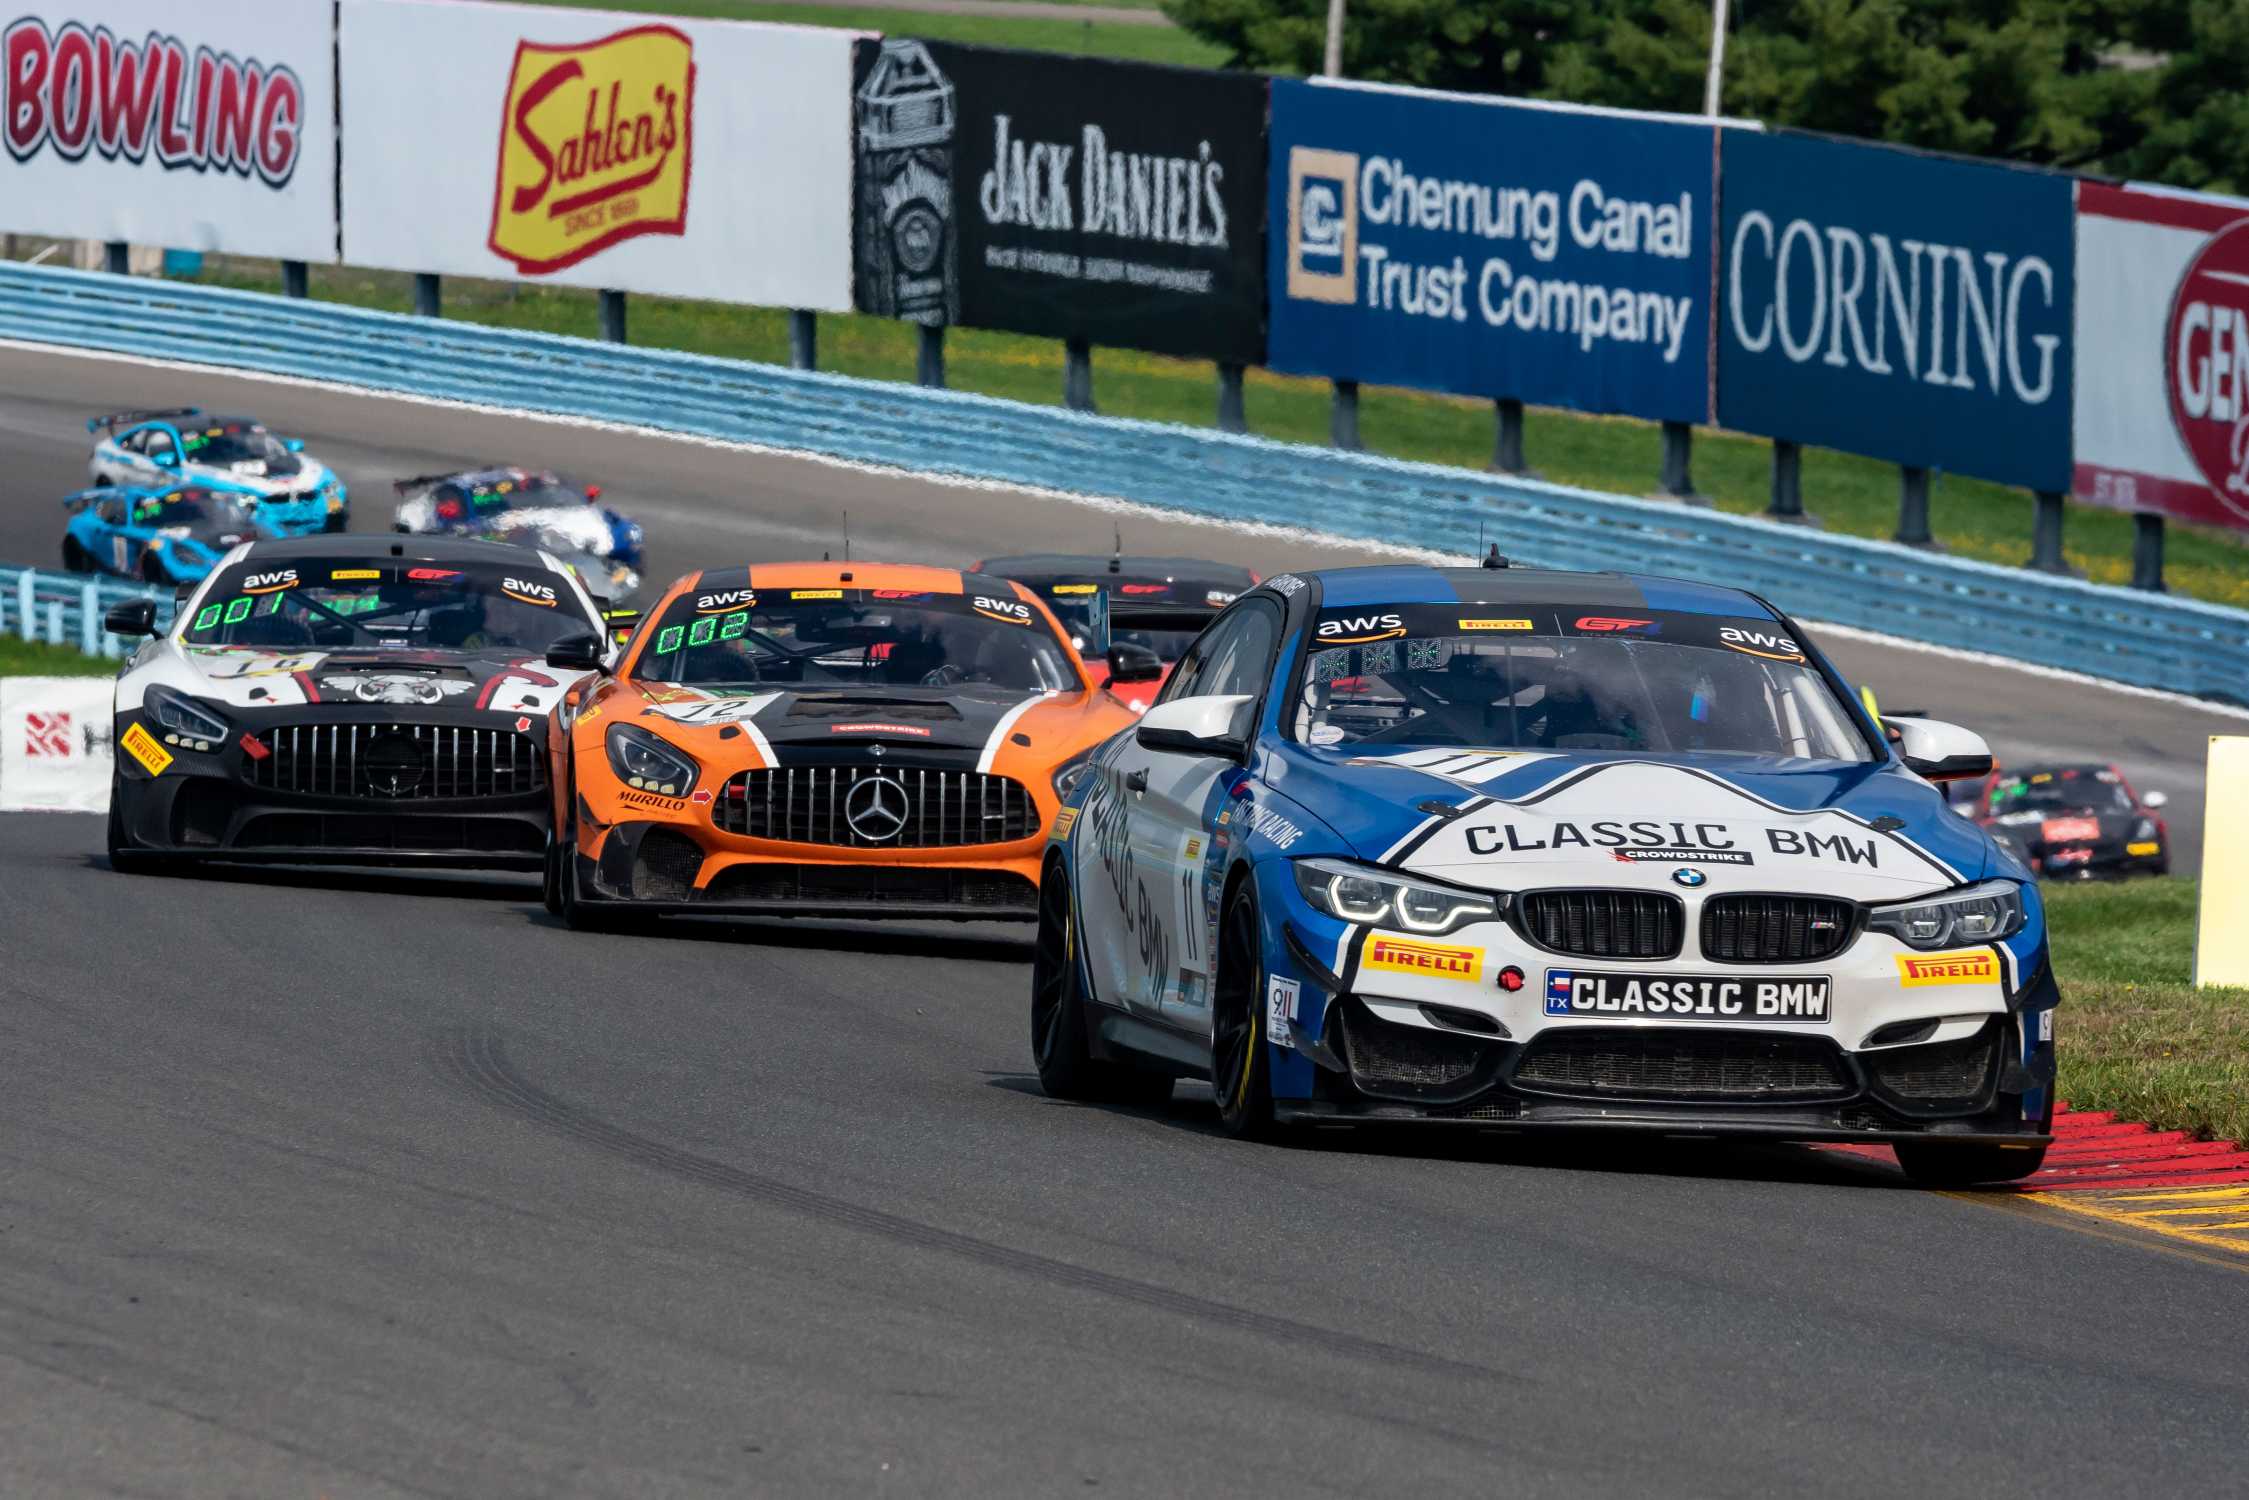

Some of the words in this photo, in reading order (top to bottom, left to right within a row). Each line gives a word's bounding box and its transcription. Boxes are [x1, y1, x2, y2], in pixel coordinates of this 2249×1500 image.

[3, 17, 303, 189] BOWLING
[511, 58, 677, 214] Sahlen's
[980, 114, 1074, 231] JACK
[1081, 124, 1229, 248] DANIEL'S
[1361, 156, 1559, 261] Chemung
[1568, 179, 1692, 258] Canal
[1360, 244, 1467, 322] Trust
[1478, 258, 1692, 363] Company
[1730, 211, 2060, 404] CORNING
[243, 569, 298, 589] aws
[503, 577, 556, 600] aws
[698, 590, 755, 608] aws
[973, 596, 1031, 618] aws
[1318, 614, 1403, 636] aws
[1719, 627, 1800, 653] aws
[128, 730, 166, 769] PIRELLI
[616, 791, 685, 811] MURILLO
[1465, 821, 1735, 856] CLASSIC
[1766, 828, 1879, 869] BMW
[1625, 850, 1745, 862] CROWDSTRIKE
[1373, 940, 1475, 974] PIRELLI
[1904, 955, 1992, 979] PIRELLI
[1548, 997, 1568, 1009] TX
[1572, 978, 1743, 1014] CLASSIC
[1756, 983, 1827, 1015] BMW
